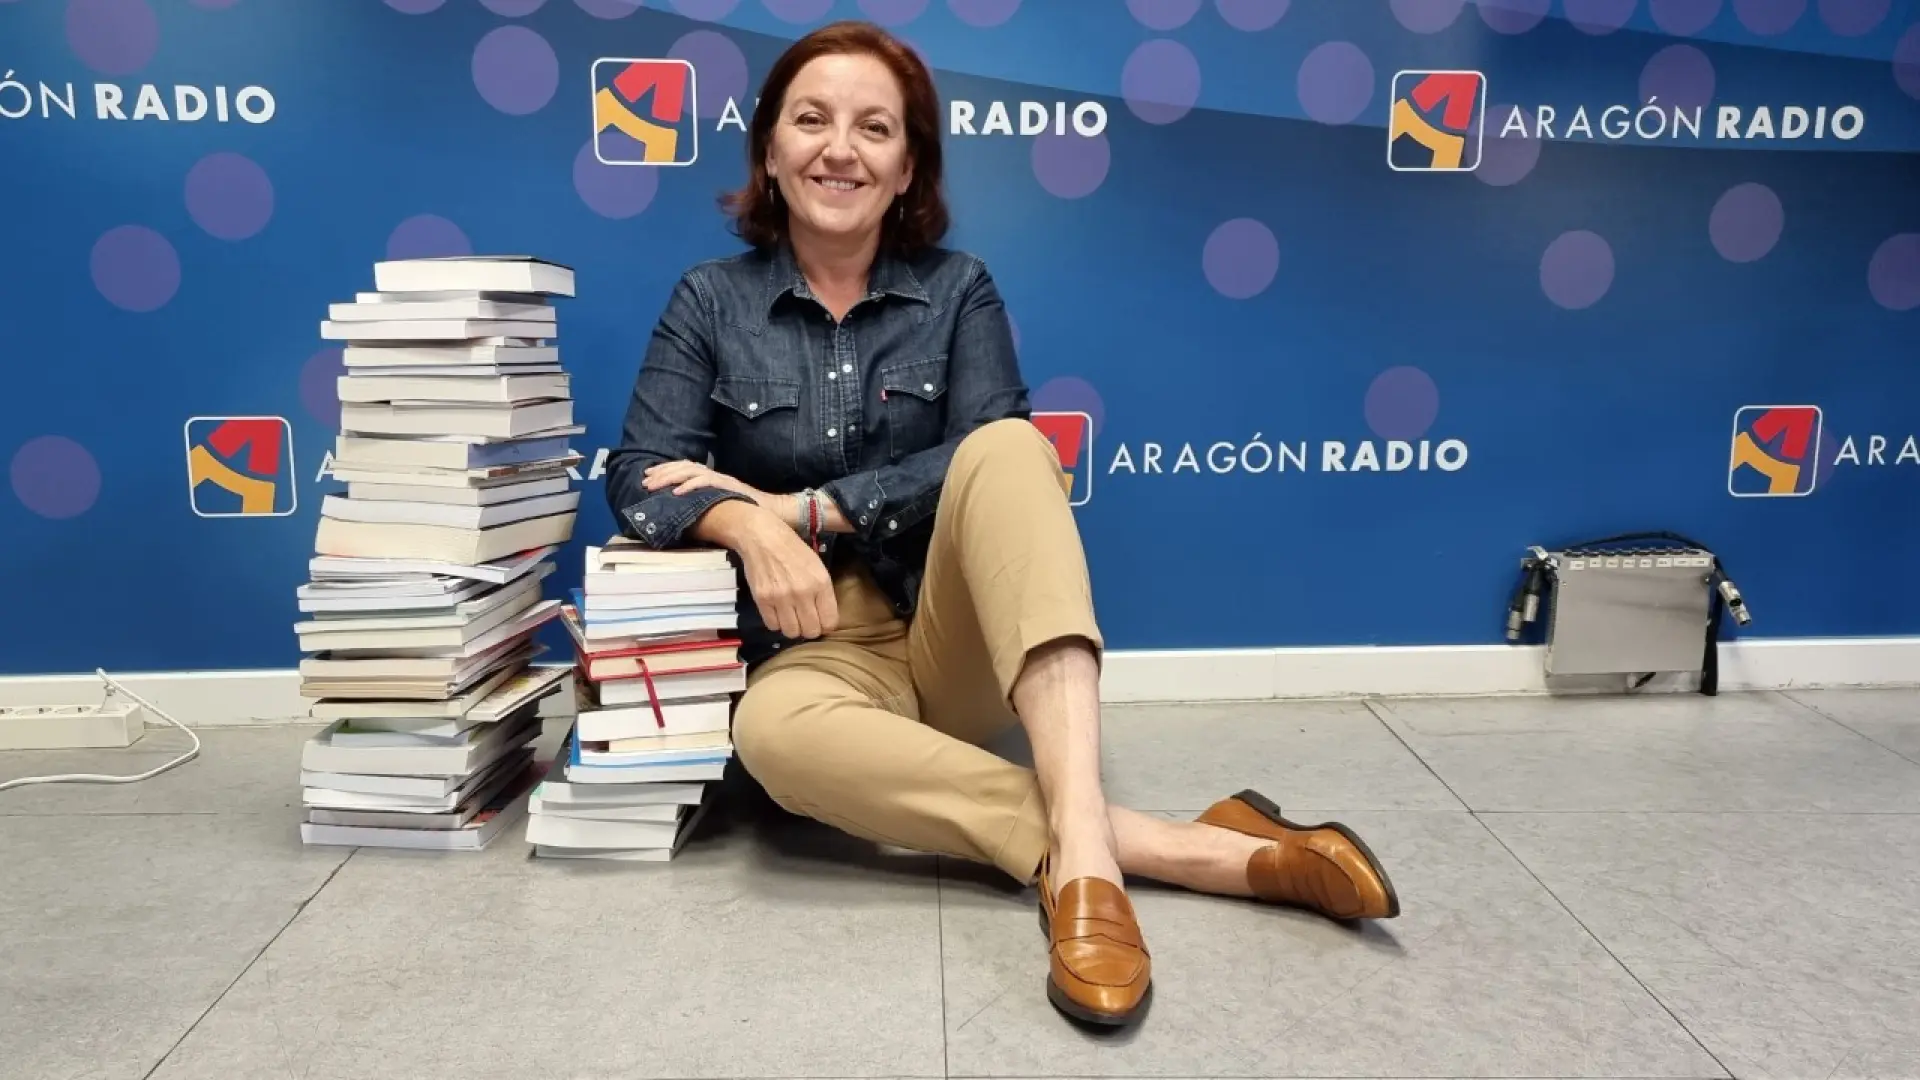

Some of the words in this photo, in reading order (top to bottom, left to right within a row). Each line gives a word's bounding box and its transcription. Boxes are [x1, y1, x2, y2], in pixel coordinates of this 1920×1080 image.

[94, 83, 276, 124] RADIO
[950, 100, 1108, 137] RADIO
[1499, 95, 1702, 139] ARAGÓN
[1716, 106, 1864, 140] RADIO
[1109, 432, 1306, 474] ARAGÓN
[1322, 439, 1468, 472] RADIO
[1833, 435, 1920, 466] ARA
